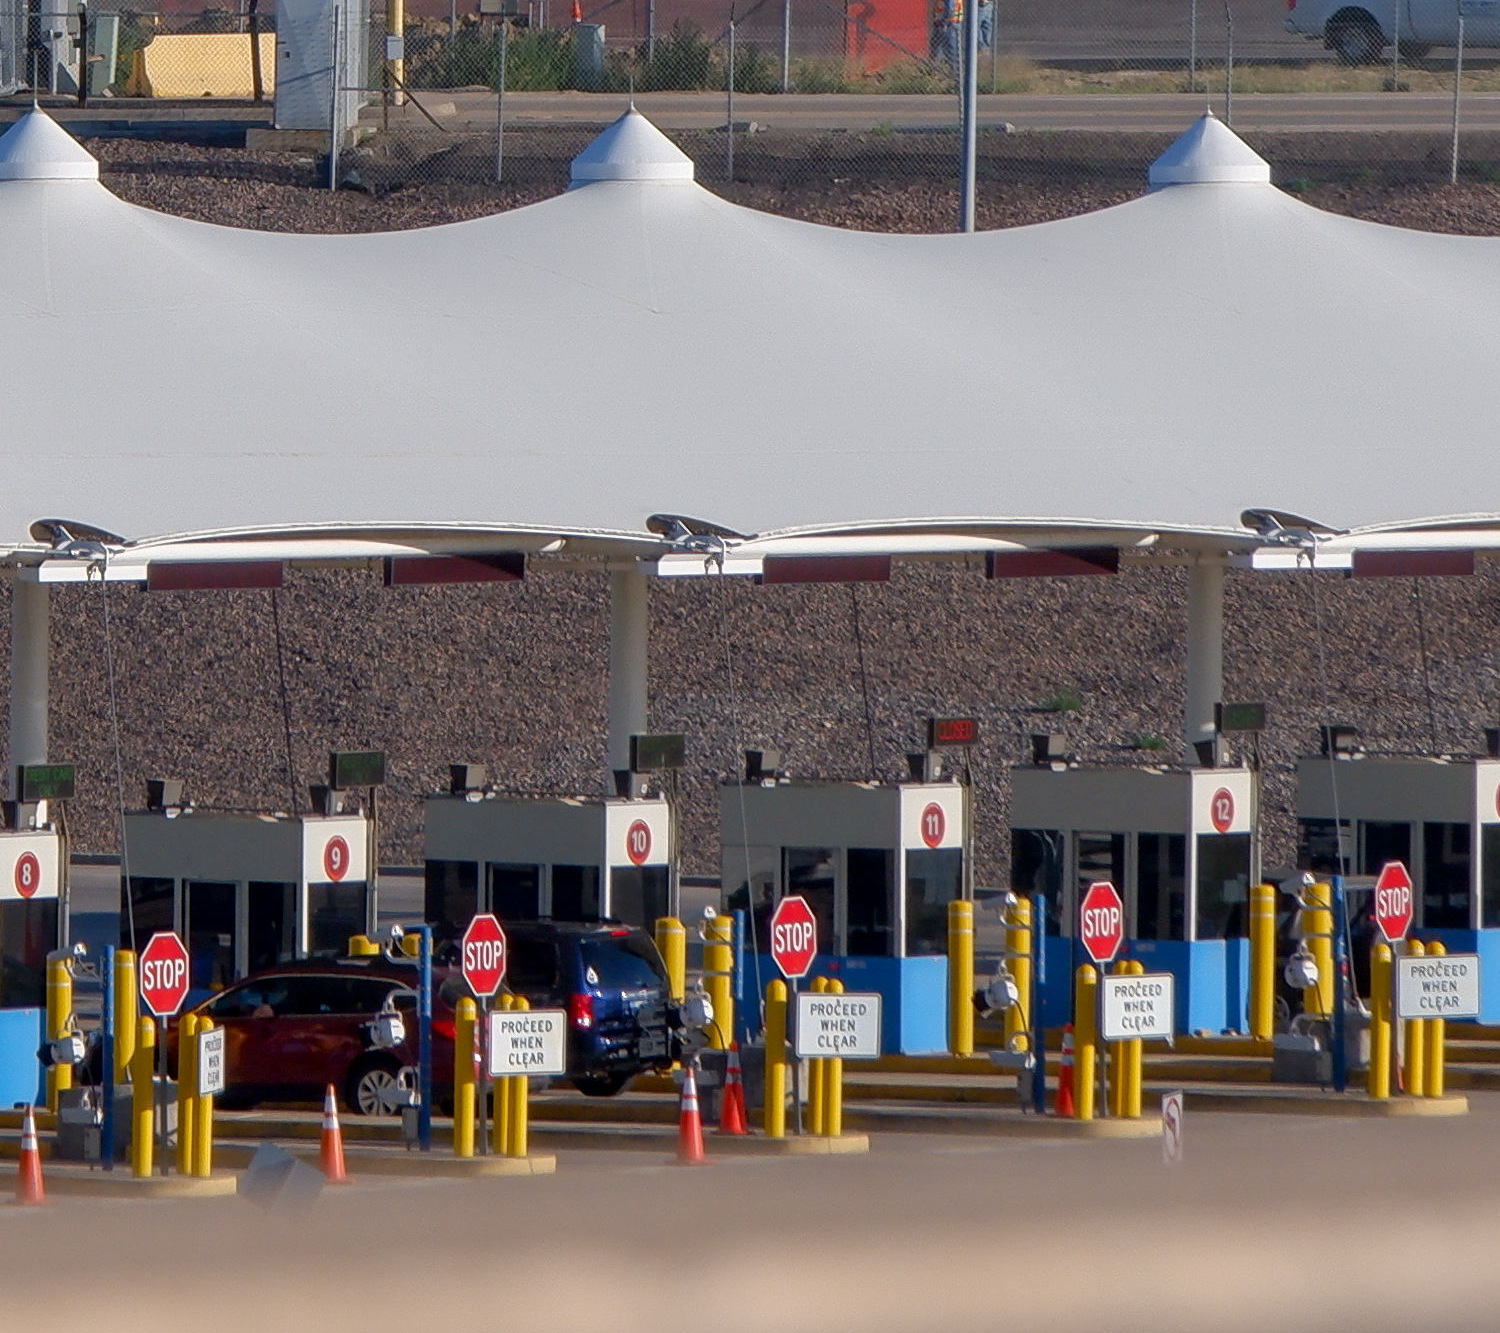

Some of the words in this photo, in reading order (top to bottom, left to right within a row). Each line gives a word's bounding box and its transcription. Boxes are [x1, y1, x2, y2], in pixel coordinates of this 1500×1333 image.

[1215, 798, 1229, 820] 12
[926, 814, 939, 836] 11
[631, 831, 647, 853] 10
[331, 846, 341, 870] 9
[22, 862, 32, 886] 8
[1378, 887, 1410, 918] STOP
[1085, 907, 1119, 938] STOP
[775, 921, 812, 954] STOP
[465, 940, 502, 971] STOP
[144, 958, 185, 990] STOP
[1410, 964, 1468, 977] PROCEED
[1114, 985, 1162, 998] PROCEED
[1421, 980, 1458, 993] WHEN
[810, 1002, 867, 1017] PROCEED
[1123, 1000, 1154, 1012] WHEN
[1419, 995, 1460, 1009] CLEAR
[501, 1019, 553, 1034] PROCEED
[820, 1019, 856, 1031] WHEN
[1121, 1014, 1155, 1028] CLEAR
[510, 1036, 543, 1049] WHEN
[817, 1034, 857, 1048] CLEAR
[508, 1051, 545, 1066] CLEAR
